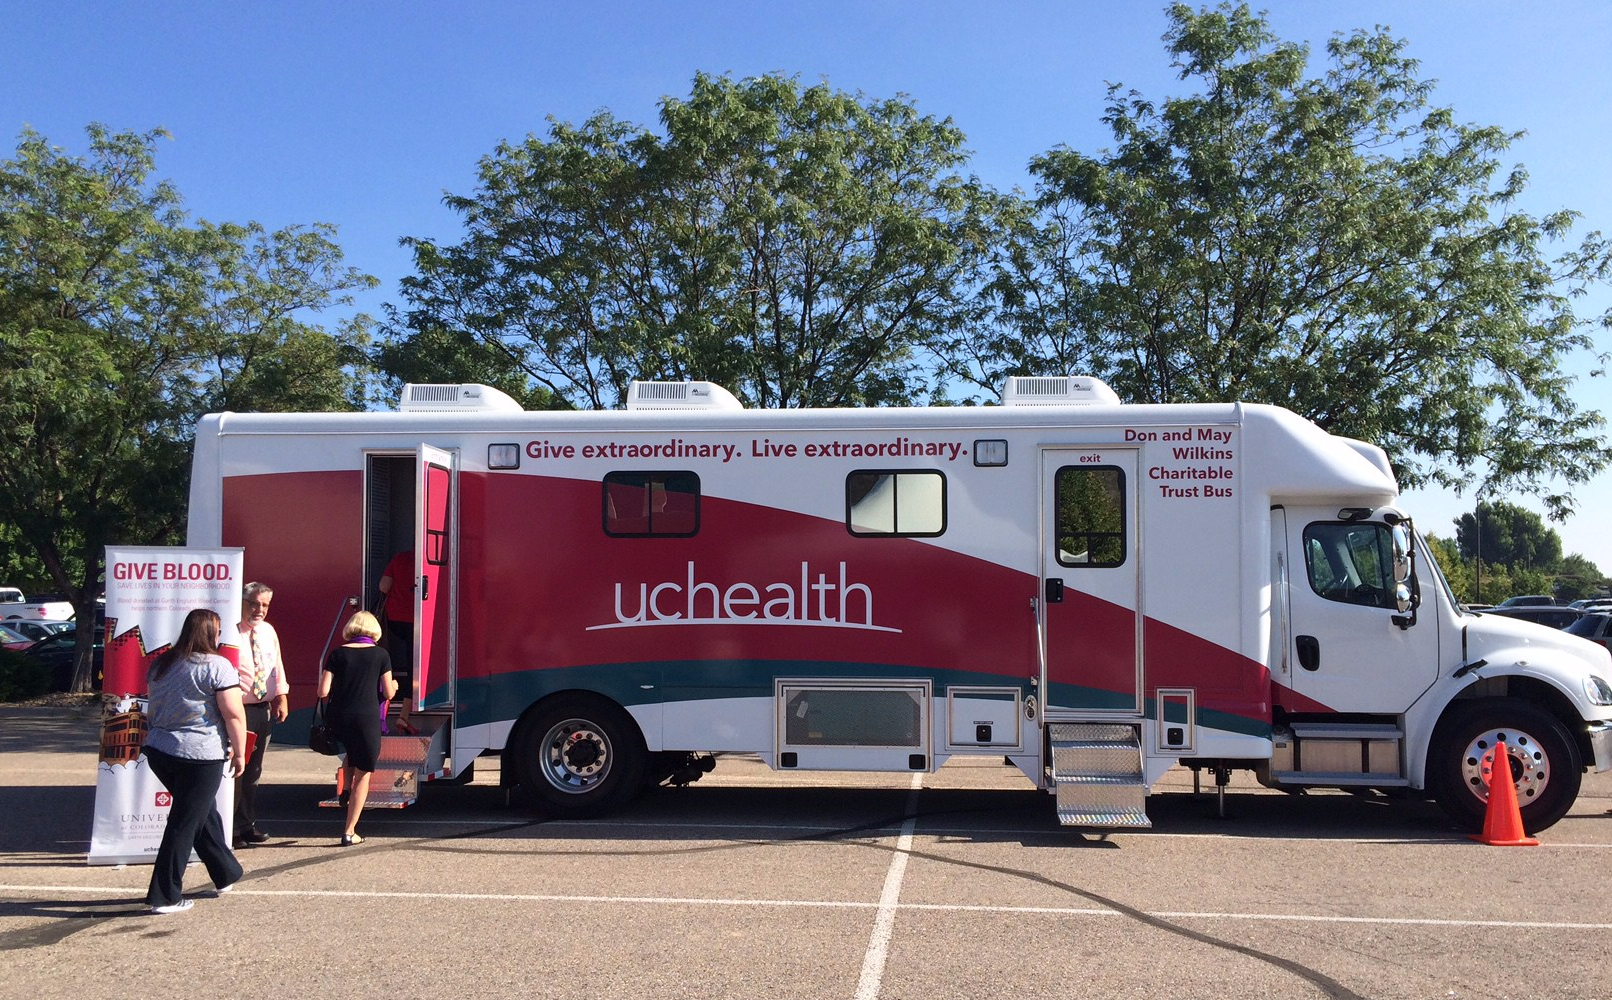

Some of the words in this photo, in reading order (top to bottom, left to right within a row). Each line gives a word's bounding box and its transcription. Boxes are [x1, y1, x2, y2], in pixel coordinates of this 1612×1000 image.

[1124, 429, 1157, 442] Don
[1162, 428, 1192, 441] and
[1197, 428, 1232, 443] May
[526, 440, 575, 458] Give
[582, 439, 742, 463] extraordinary.
[752, 440, 797, 457] Live
[804, 438, 968, 461] extraordinary.
[1172, 447, 1233, 460] Wilkins
[1079, 453, 1101, 463] exit
[1148, 466, 1233, 480] Charitable
[1159, 485, 1199, 498] Trust
[1203, 485, 1233, 498] Bus
[114, 562, 158, 580] GIVE
[163, 563, 232, 581] BLOOD.
[614, 561, 873, 626] uchealth
